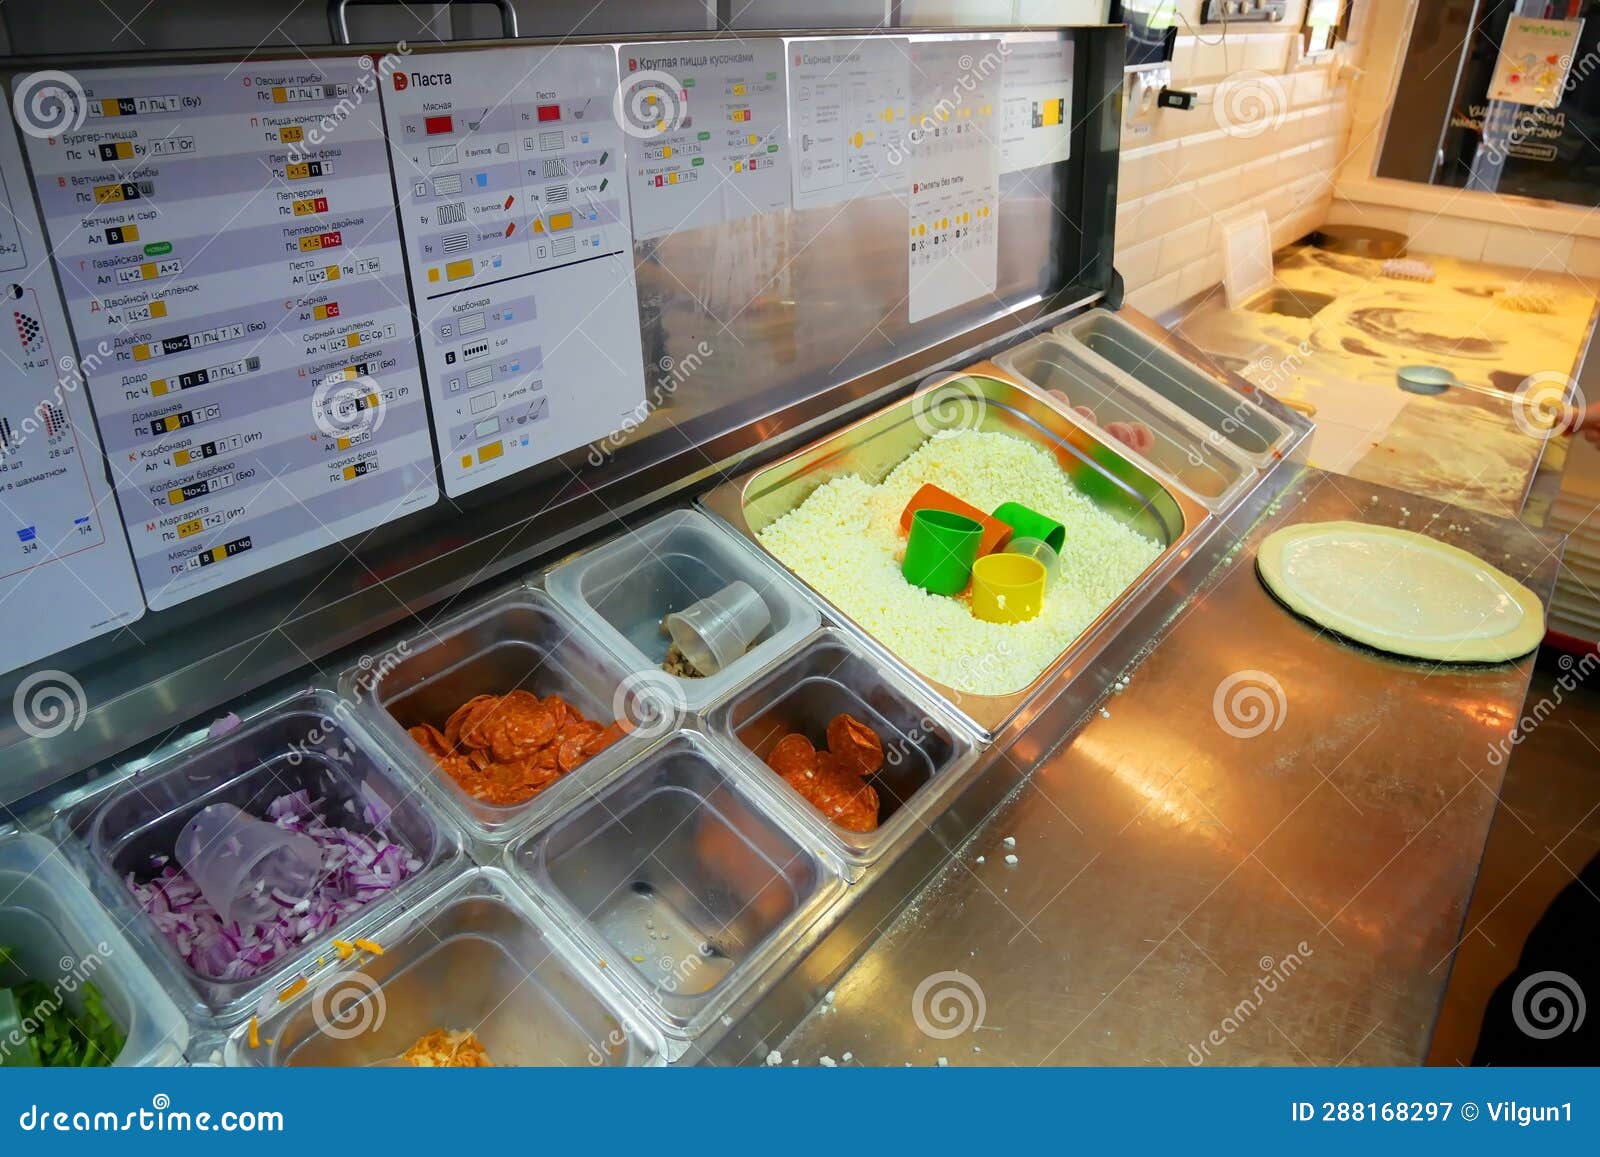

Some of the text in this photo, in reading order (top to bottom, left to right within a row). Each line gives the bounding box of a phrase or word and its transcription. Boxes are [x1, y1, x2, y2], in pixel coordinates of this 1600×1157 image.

[640, 55, 753, 70] Круглая пицца кусочками
[255, 74, 321, 86] Овощи грибы
[411, 72, 452, 87] Паста
[257, 91, 270, 100] Пс
[300, 88, 312, 99] Пц
[337, 87, 347, 95] Бн
[536, 91, 556, 99] Песто
[120, 97, 201, 112] Чо Пц (Бу)
[423, 101, 452, 112] Мясная
[406, 125, 416, 134] Пс
[62, 130, 138, 145] Бургер-пицца
[265, 132, 277, 141] Пс
[67, 140, 192, 160] Пс Бу Ог
[319, 149, 342, 160] фреш
[71, 173, 116, 186] Ветчина
[273, 169, 284, 178] Пс
[76, 192, 91, 202] Пс
[276, 188, 324, 201] Пепперони
[279, 206, 291, 215] Пс
[81, 213, 125, 228] Ветчина
[137, 210, 157, 221] сыр
[420, 216, 429, 224] Бу
[283, 216, 364, 237] Пепперони двойная
[88, 235, 102, 244] Ал
[286, 242, 298, 251] Пс
[92, 254, 144, 269] Гавайская
[290, 260, 314, 270] Песто
[292, 275, 304, 284] Ал
[343, 265, 354, 274] Пе
[369, 260, 378, 270] Бн
[97, 276, 111, 284] Ал
[104, 292, 149, 309] Двойной
[296, 295, 327, 306] Сырная
[452, 298, 491, 312] Карбонара
[108, 316, 122, 325] Ал
[300, 312, 311, 321] Ал
[303, 320, 375, 342] Сырный цыпленок
[114, 333, 152, 348] Диабло
[117, 352, 130, 361] Пс
[204, 334, 218, 343] Пц
[247, 322, 267, 333] (Бю)
[305, 346, 317, 355] Ал
[37, 359, 48, 367] шт
[309, 350, 382, 375] Цыпленок барбекю
[380, 358, 396, 369] (Бю)
[121, 373, 148, 386] Додо
[126, 367, 235, 400] Пс Пц
[131, 403, 182, 424] Домашняя
[135, 408, 219, 437] Пс Ог
[63, 446, 74, 455] шт
[140, 438, 192, 458] Карбонара
[145, 432, 263, 472] Ал Сс (Ит)
[325, 444, 335, 452] Ал
[357, 449, 377, 461] фреш
[11, 461, 23, 469] шт
[15, 468, 67, 487] шахматном
[149, 462, 236, 494] Колбаски барбекю
[330, 462, 378, 482] Пс Чо Пц
[152, 497, 166, 507] Пс
[236, 469, 256, 481] (Бю)
[159, 506, 209, 528] Маргарита
[162, 531, 176, 541] Пс
[226, 507, 245, 519] (Ит)
[22, 543, 37, 554] 3/4
[168, 544, 203, 561] Мясная
[170, 540, 250, 574] Пс Чо
